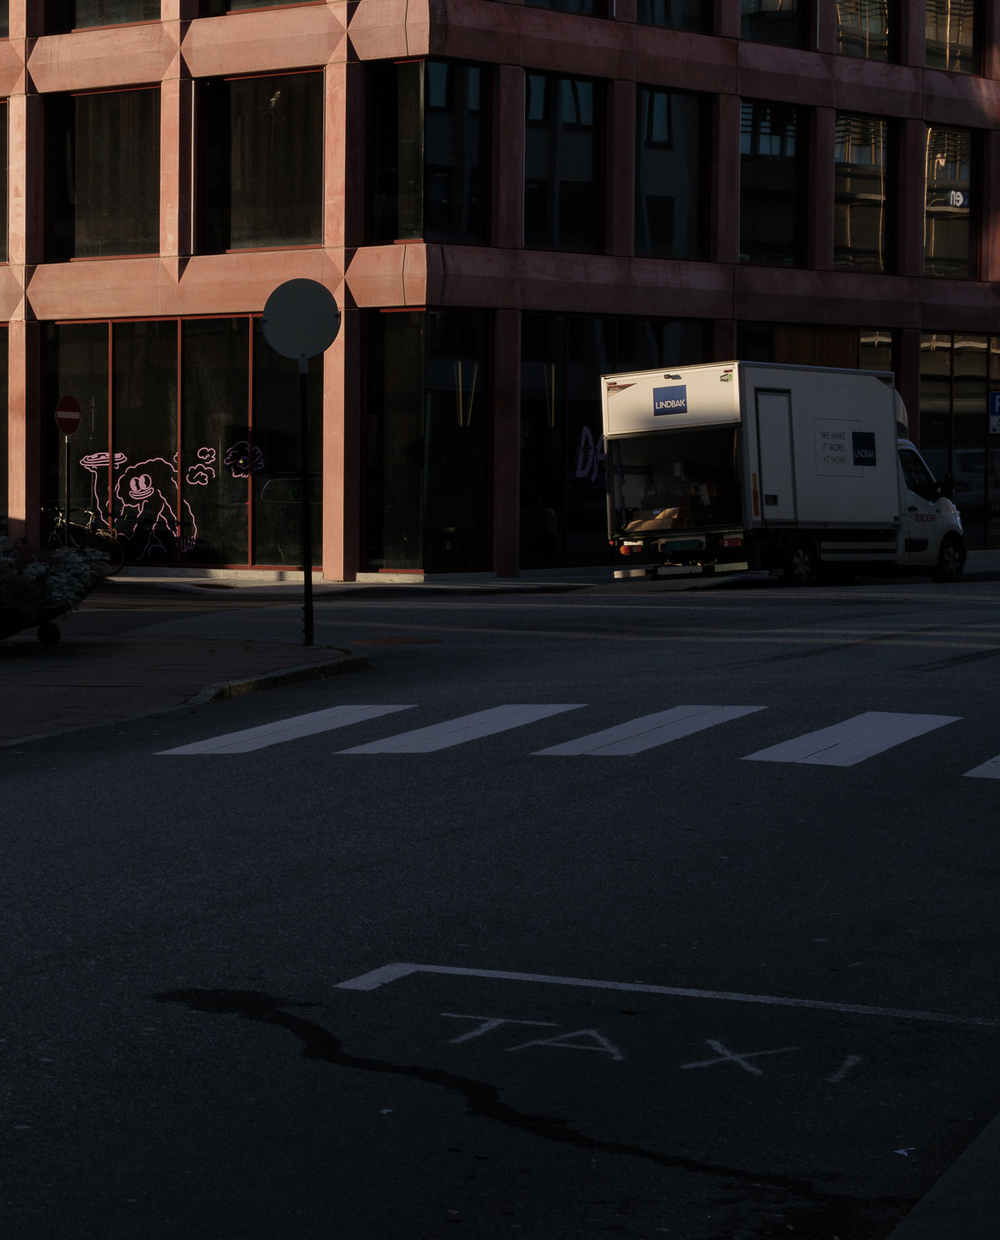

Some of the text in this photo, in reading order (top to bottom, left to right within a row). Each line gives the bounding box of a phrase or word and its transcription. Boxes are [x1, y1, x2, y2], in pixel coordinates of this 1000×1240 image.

[655, 398, 686, 410] LINDBAK
[820, 431, 846, 441] WE MAKE
[822, 443, 828, 451] IT
[854, 449, 876, 458] LINDBAK
[823, 455, 847, 464] AT WORK
[915, 513, 937, 523] RICOH
